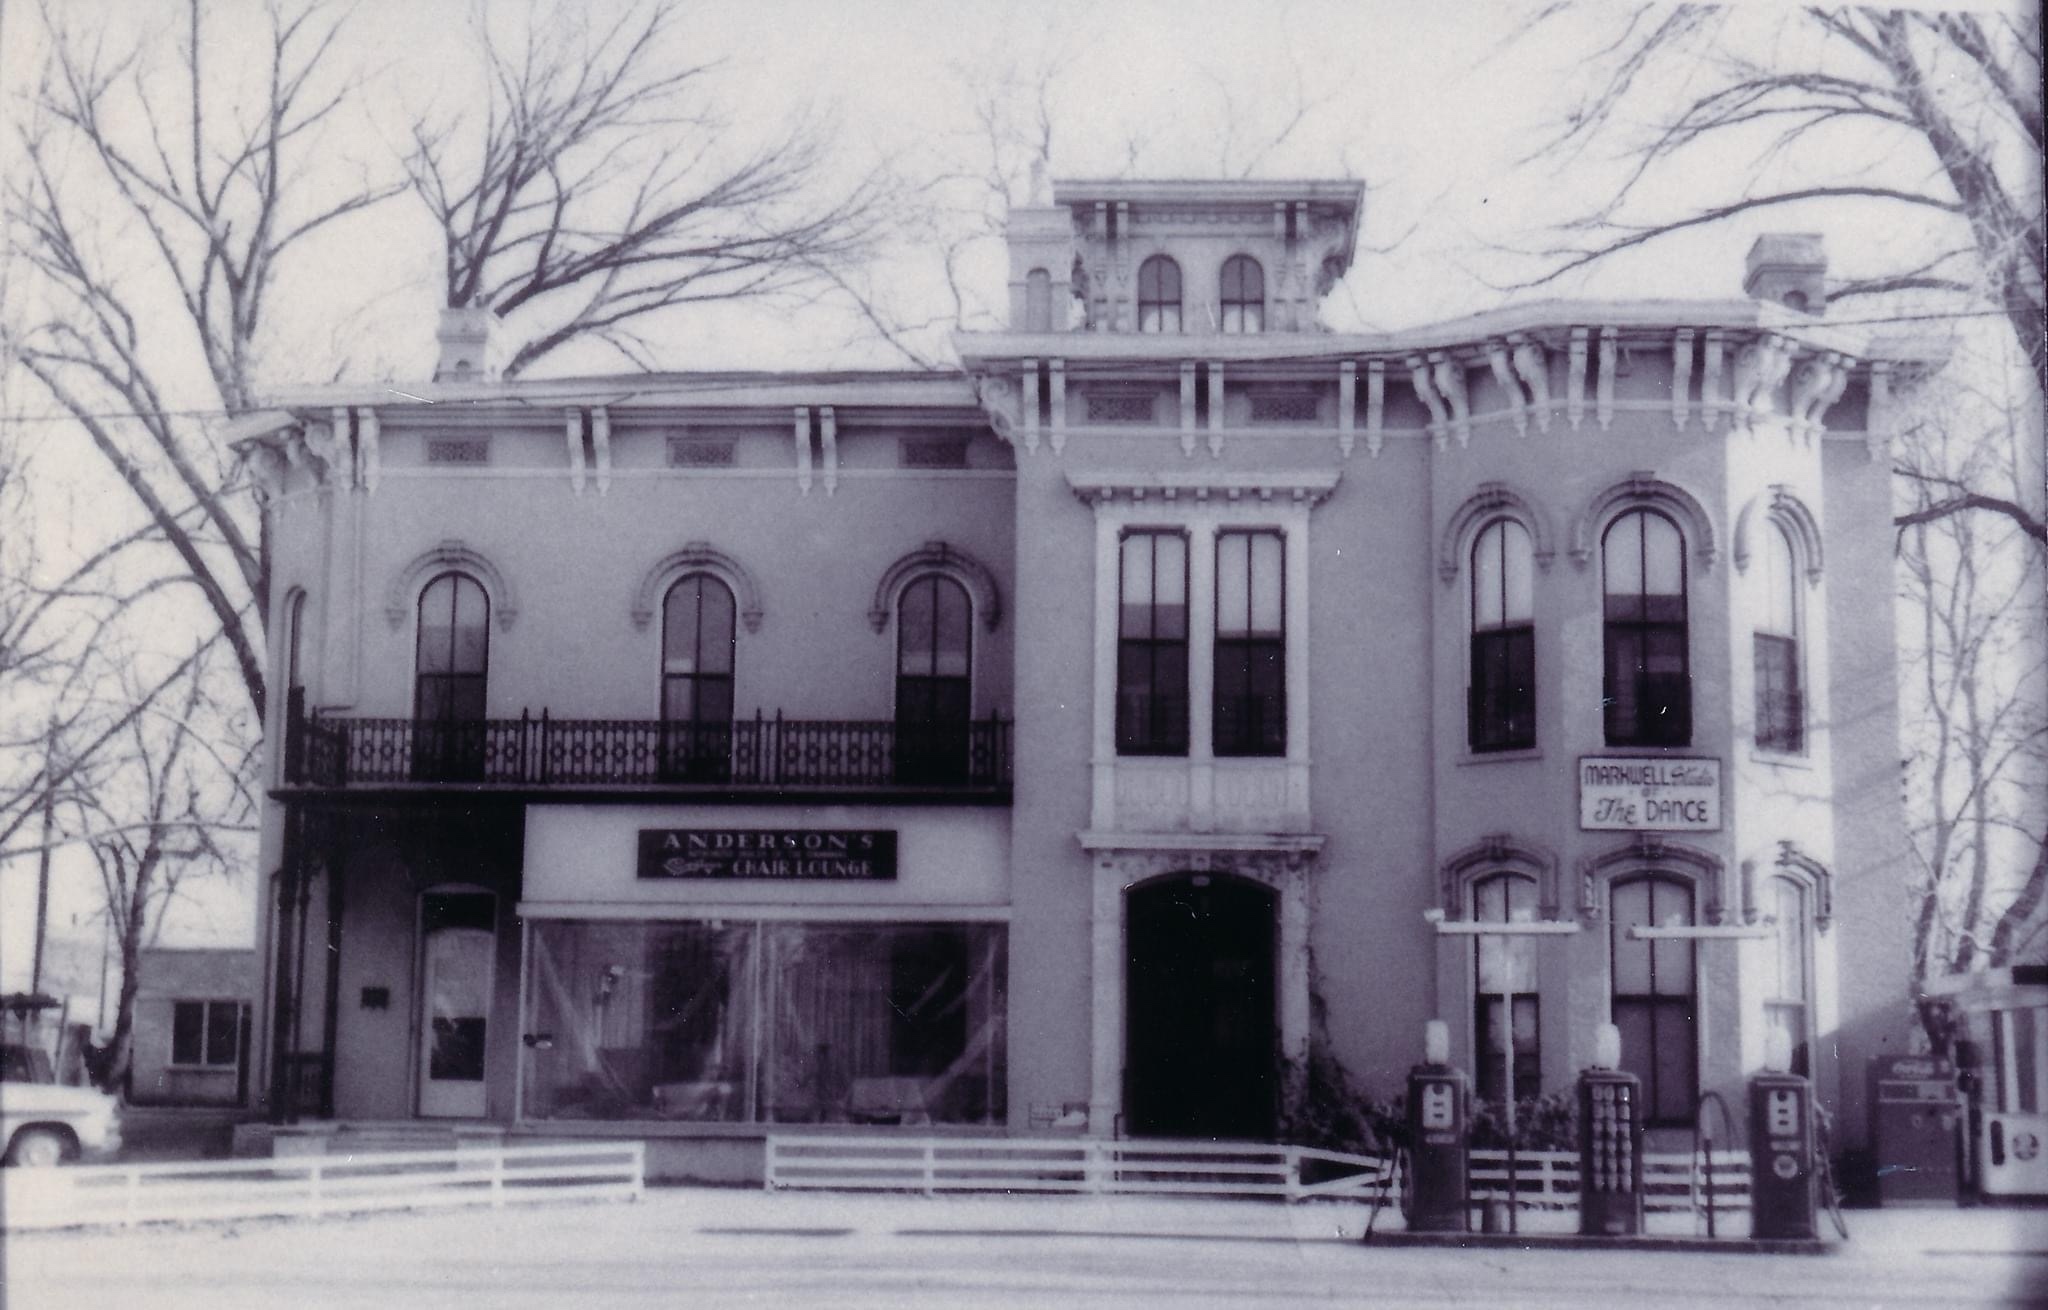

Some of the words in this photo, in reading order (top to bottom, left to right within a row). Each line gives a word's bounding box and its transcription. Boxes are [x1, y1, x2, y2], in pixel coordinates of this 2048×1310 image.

[1585, 765, 1670, 786] MARKWELL
[1594, 798, 1637, 825] The
[1646, 800, 1708, 823] DANCE
[733, 860, 791, 876] CHAIR
[797, 860, 872, 876] LOUNGE
